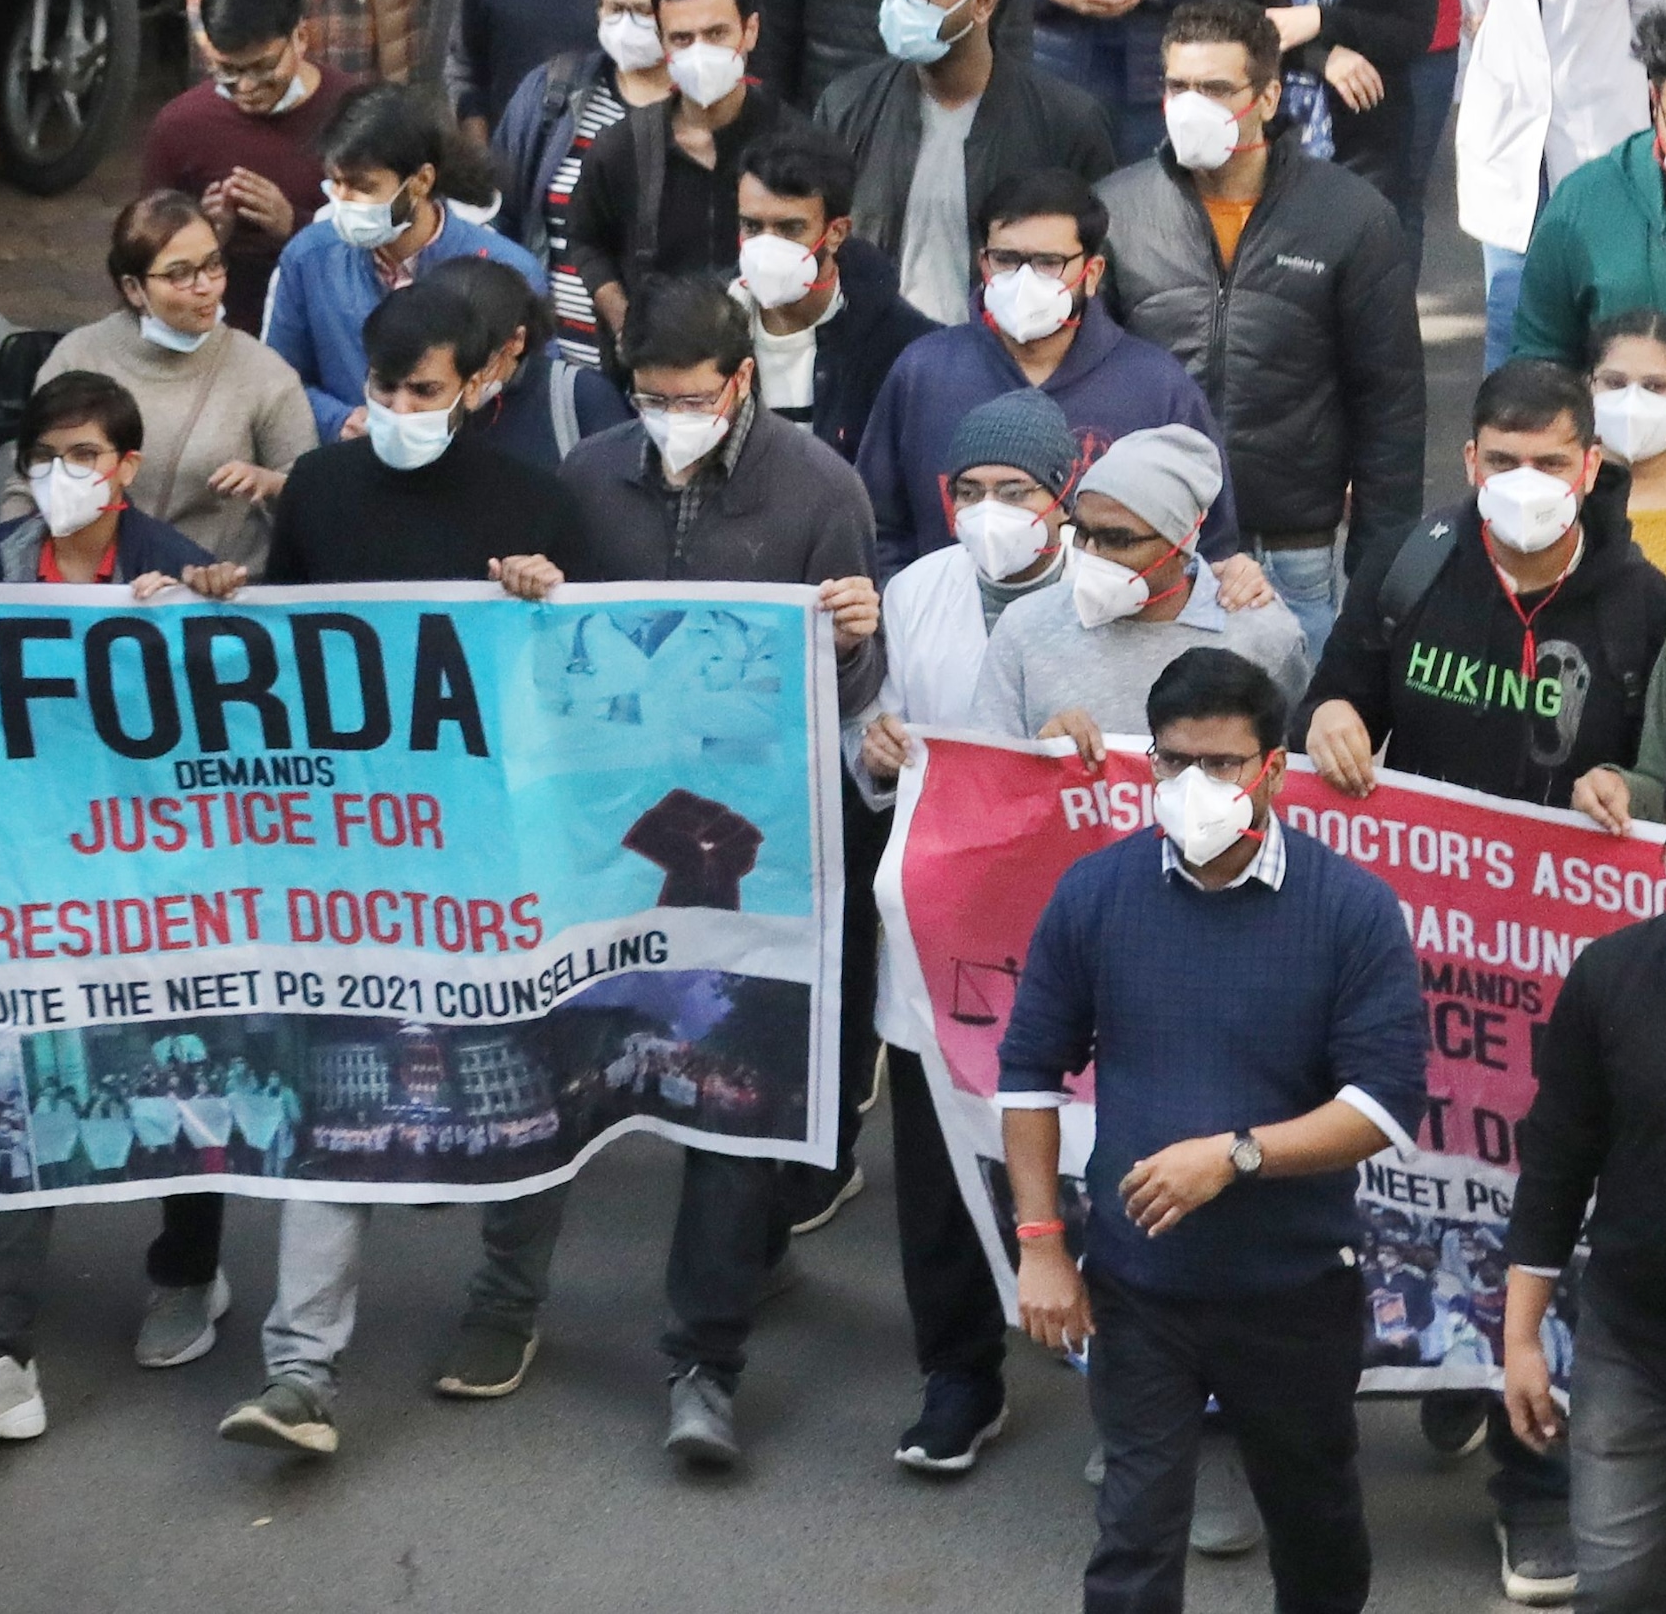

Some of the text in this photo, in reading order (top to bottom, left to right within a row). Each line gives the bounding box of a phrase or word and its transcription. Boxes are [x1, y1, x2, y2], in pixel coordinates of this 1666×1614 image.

[1407, 642, 1562, 717] HIKING
[174, 756, 336, 790] DEMANDS
[70, 791, 444, 855] JUSTICE FOR
[1287, 804, 1516, 890] DOCTOR'S
[288, 888, 544, 953] DOCTORS
[79, 981, 154, 1018] THE
[167, 970, 261, 1012] NEET
[275, 970, 324, 1007] PG
[337, 974, 423, 1013] 2021
[435, 930, 669, 1018] COUNSELLING
[1365, 1159, 1450, 1211] NEET
